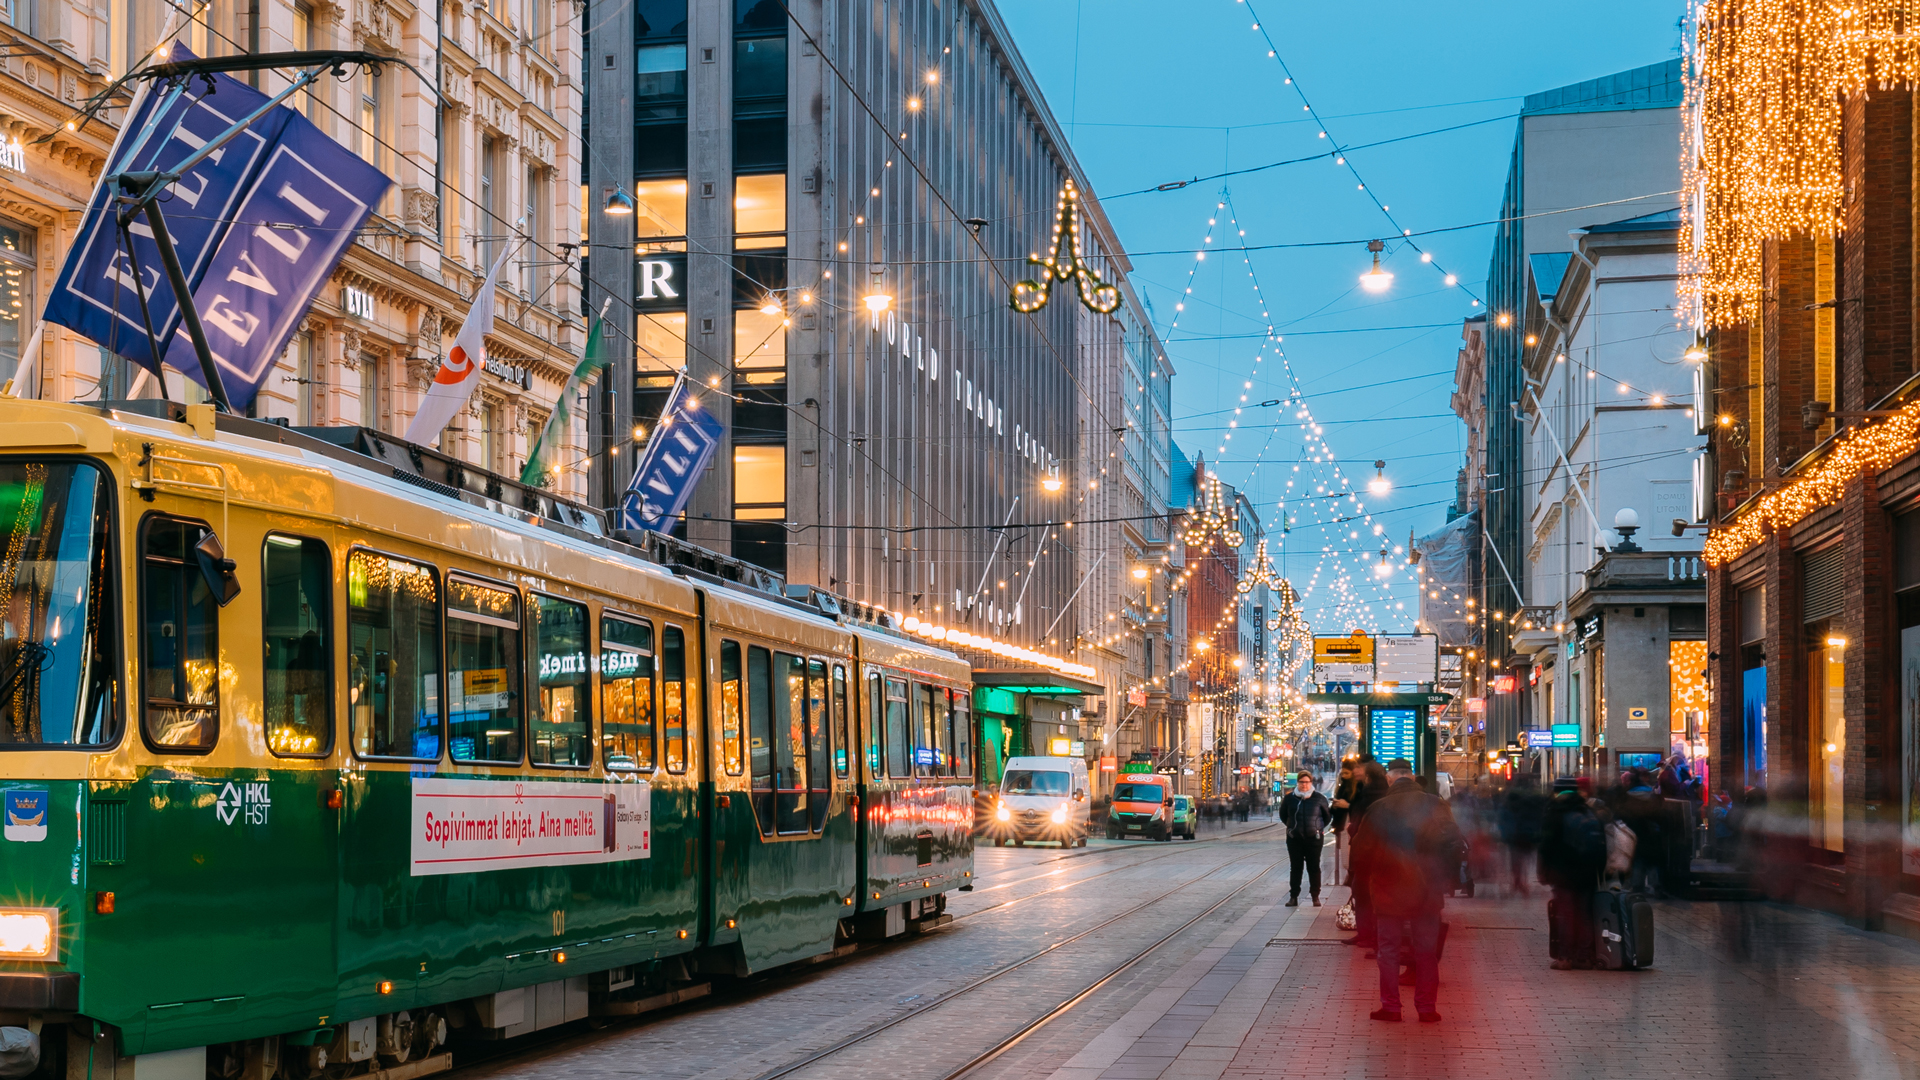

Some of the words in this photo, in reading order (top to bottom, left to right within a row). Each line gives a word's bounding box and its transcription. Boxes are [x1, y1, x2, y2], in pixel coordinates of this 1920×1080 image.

[203, 181, 330, 347] EVLI
[636, 260, 679, 299] R
[347, 286, 374, 321] EVLI
[485, 351, 515, 382] Helsingin
[515, 364, 525, 386] OP
[956, 369, 1003, 436] TRADE
[635, 428, 700, 526] EVLI
[1656, 505, 1687, 513] LITONII
[1657, 493, 1686, 501] DOMUS
[1323, 673, 1329, 681] 4
[1353, 665, 1373, 673] 0401
[1203, 714, 1212, 742] aleksi
[1236, 721, 1244, 745] aleksi
[245, 783, 271, 803] HKL
[245, 803, 271, 825] HST
[425, 811, 498, 848] Sopivimmat
[502, 811, 535, 846] lahjat.
[539, 811, 561, 838] Aina
[564, 810, 596, 837] meiltä.
[552, 910, 565, 936] 101
